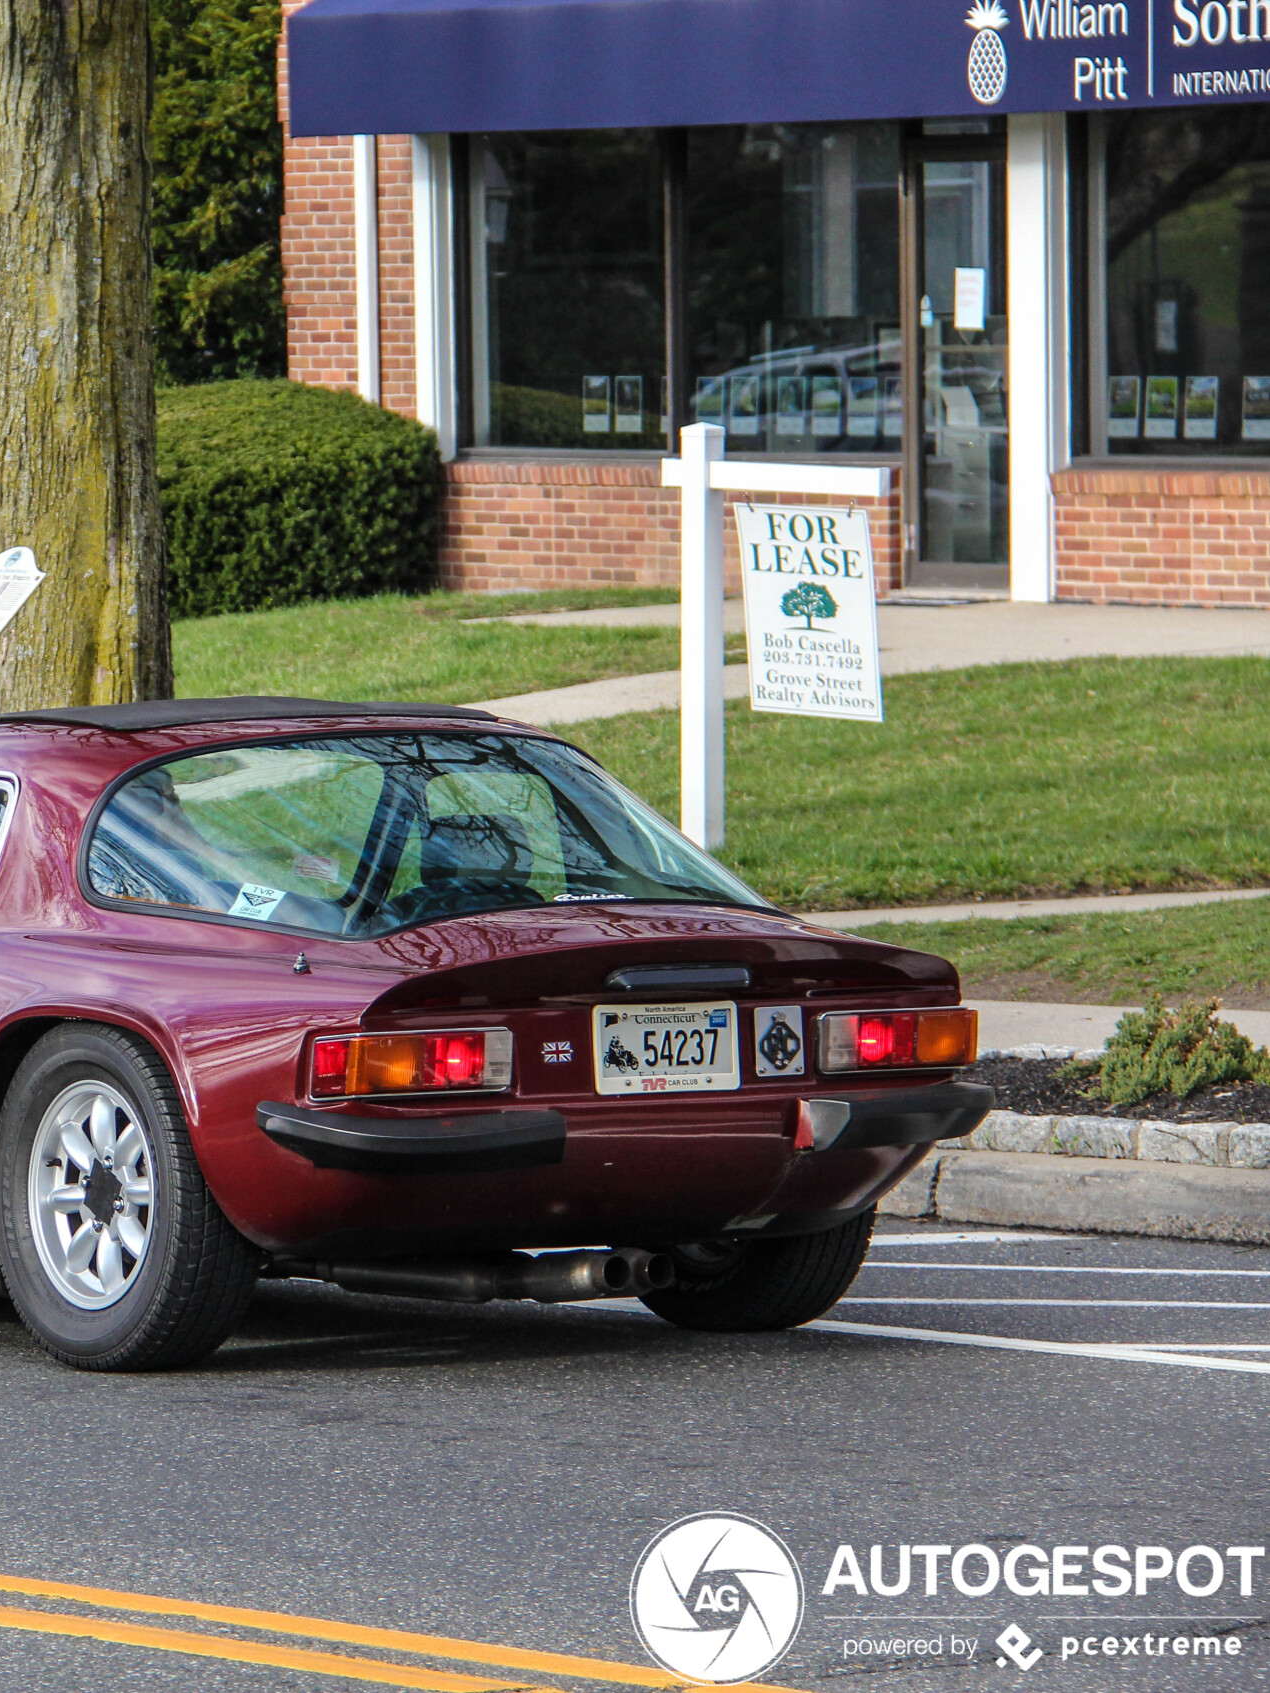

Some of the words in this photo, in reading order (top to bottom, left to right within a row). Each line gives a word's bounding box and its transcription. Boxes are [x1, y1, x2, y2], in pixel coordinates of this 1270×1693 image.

[1019, 0, 1128, 40] William
[1074, 56, 1129, 101] Pitt
[766, 512, 840, 545] FOR
[750, 542, 864, 579] LEASE
[764, 632, 793, 649] Bob
[798, 635, 861, 655] Cascella
[763, 650, 864, 671] 203.731.7492
[766, 669, 812, 687] Grove
[816, 673, 863, 692] Street
[756, 684, 804, 708] Realty
[810, 690, 875, 709] Advisors
[253, 887, 274, 896] TVR
[635, 1014, 696, 1025] Connecticut
[643, 1028, 719, 1068] 54237
[641, 1077, 667, 1091] TVR
[681, 1078, 699, 1086] CLUB
